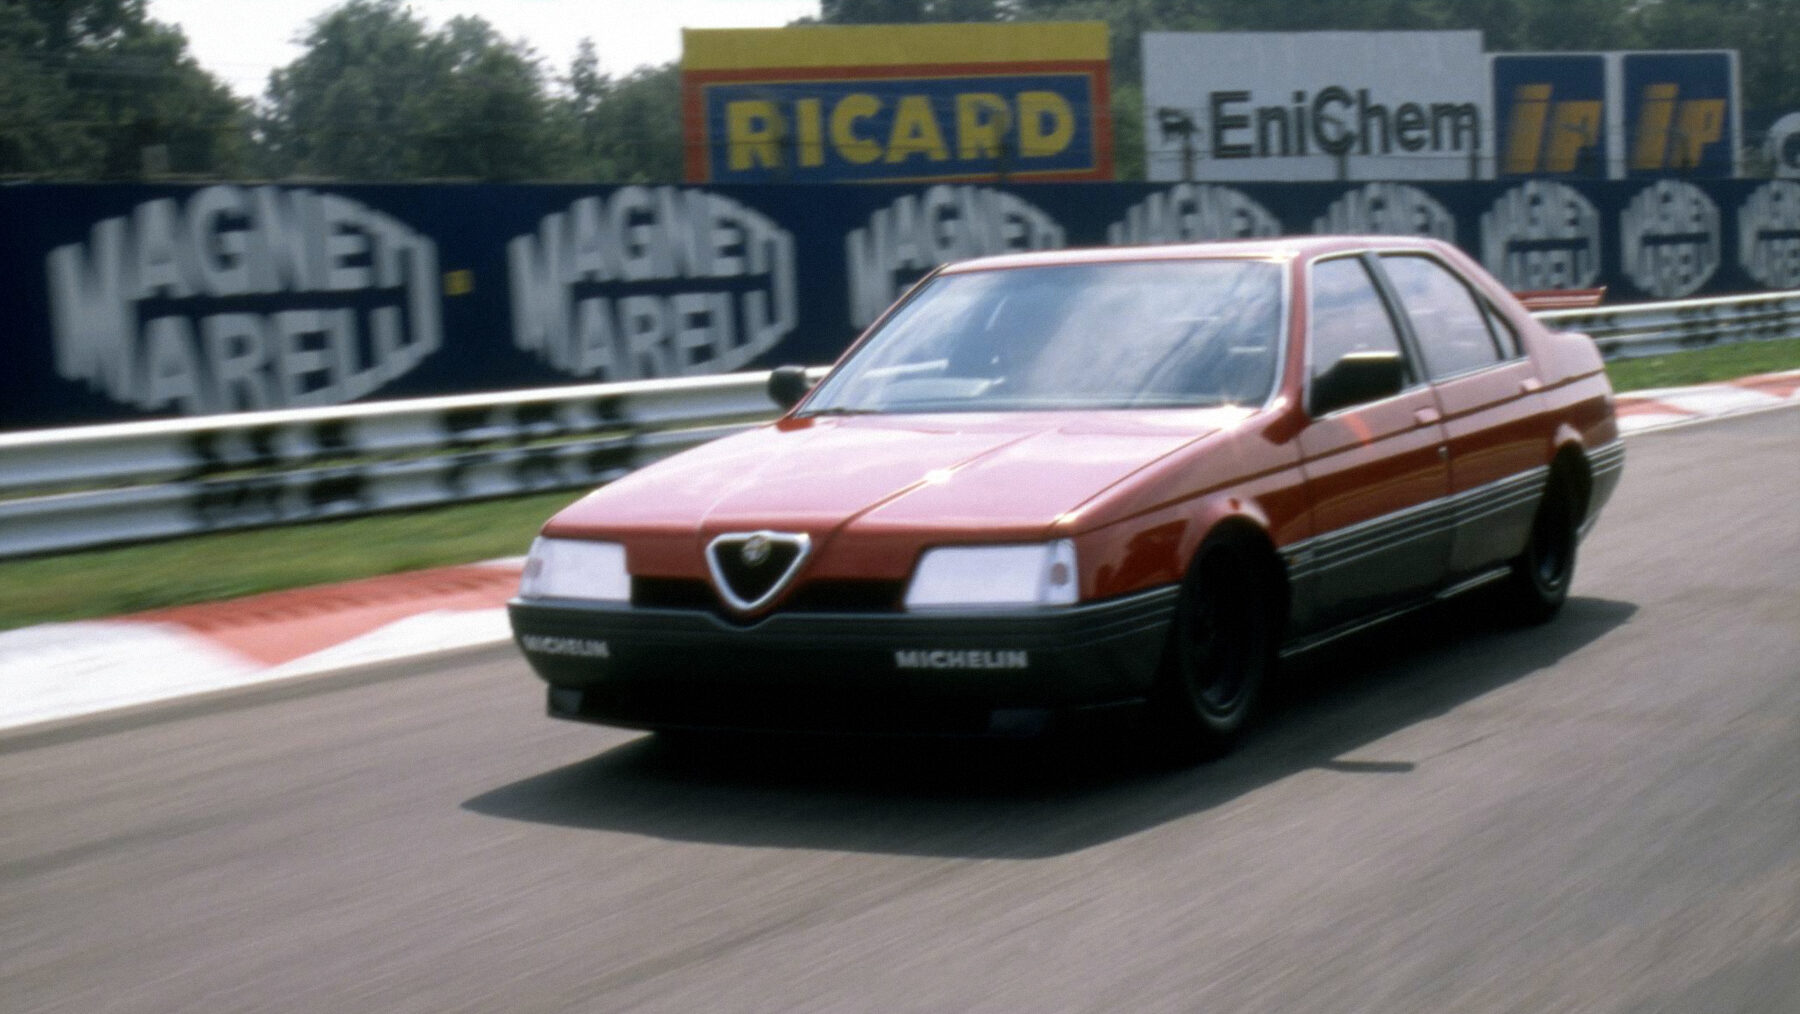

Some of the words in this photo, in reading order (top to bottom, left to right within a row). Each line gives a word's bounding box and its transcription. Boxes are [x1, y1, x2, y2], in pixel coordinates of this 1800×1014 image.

[725, 90, 1076, 171] RICARD
[1208, 86, 1481, 159] EniChem
[521, 634, 609, 658] MICHELIN
[895, 650, 1028, 669] MICHELIN
